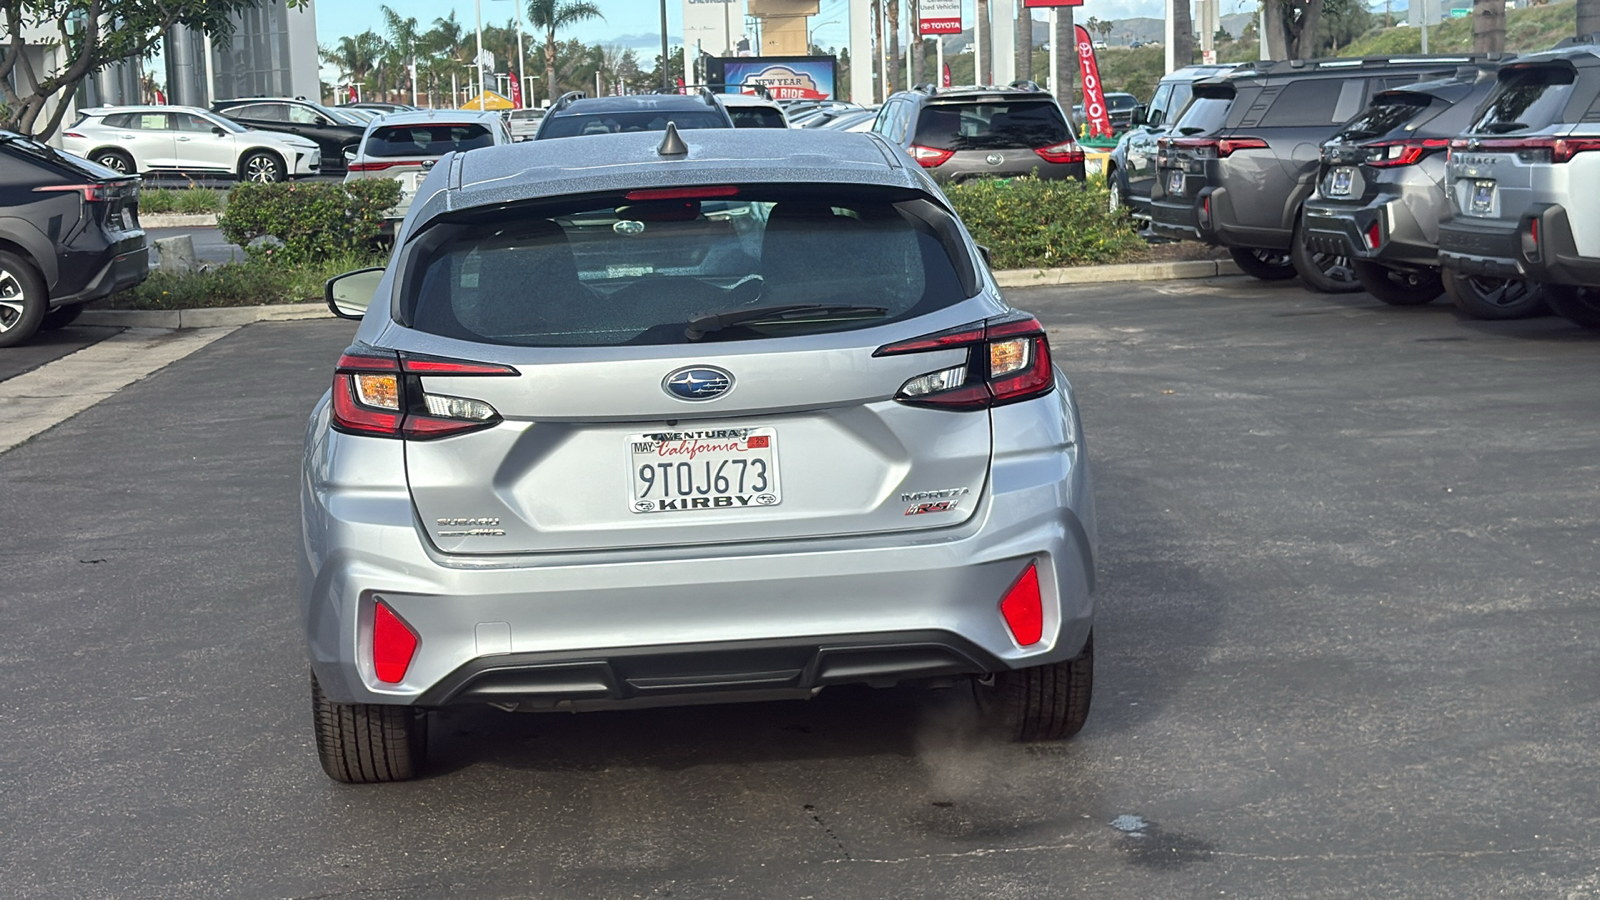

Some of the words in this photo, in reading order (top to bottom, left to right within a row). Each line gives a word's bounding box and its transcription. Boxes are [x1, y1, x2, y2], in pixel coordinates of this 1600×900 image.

[755, 78, 776, 86] NEW
[777, 78, 802, 86] YEAR
[780, 88, 805, 99] RIDE
[1083, 60, 1102, 132] TOYOT
[634, 442, 653, 454] MAY
[658, 438, 747, 460] California
[901, 487, 970, 502] IMPREZA
[659, 494, 753, 511] KIRBY
[437, 517, 499, 526] SUBARU
